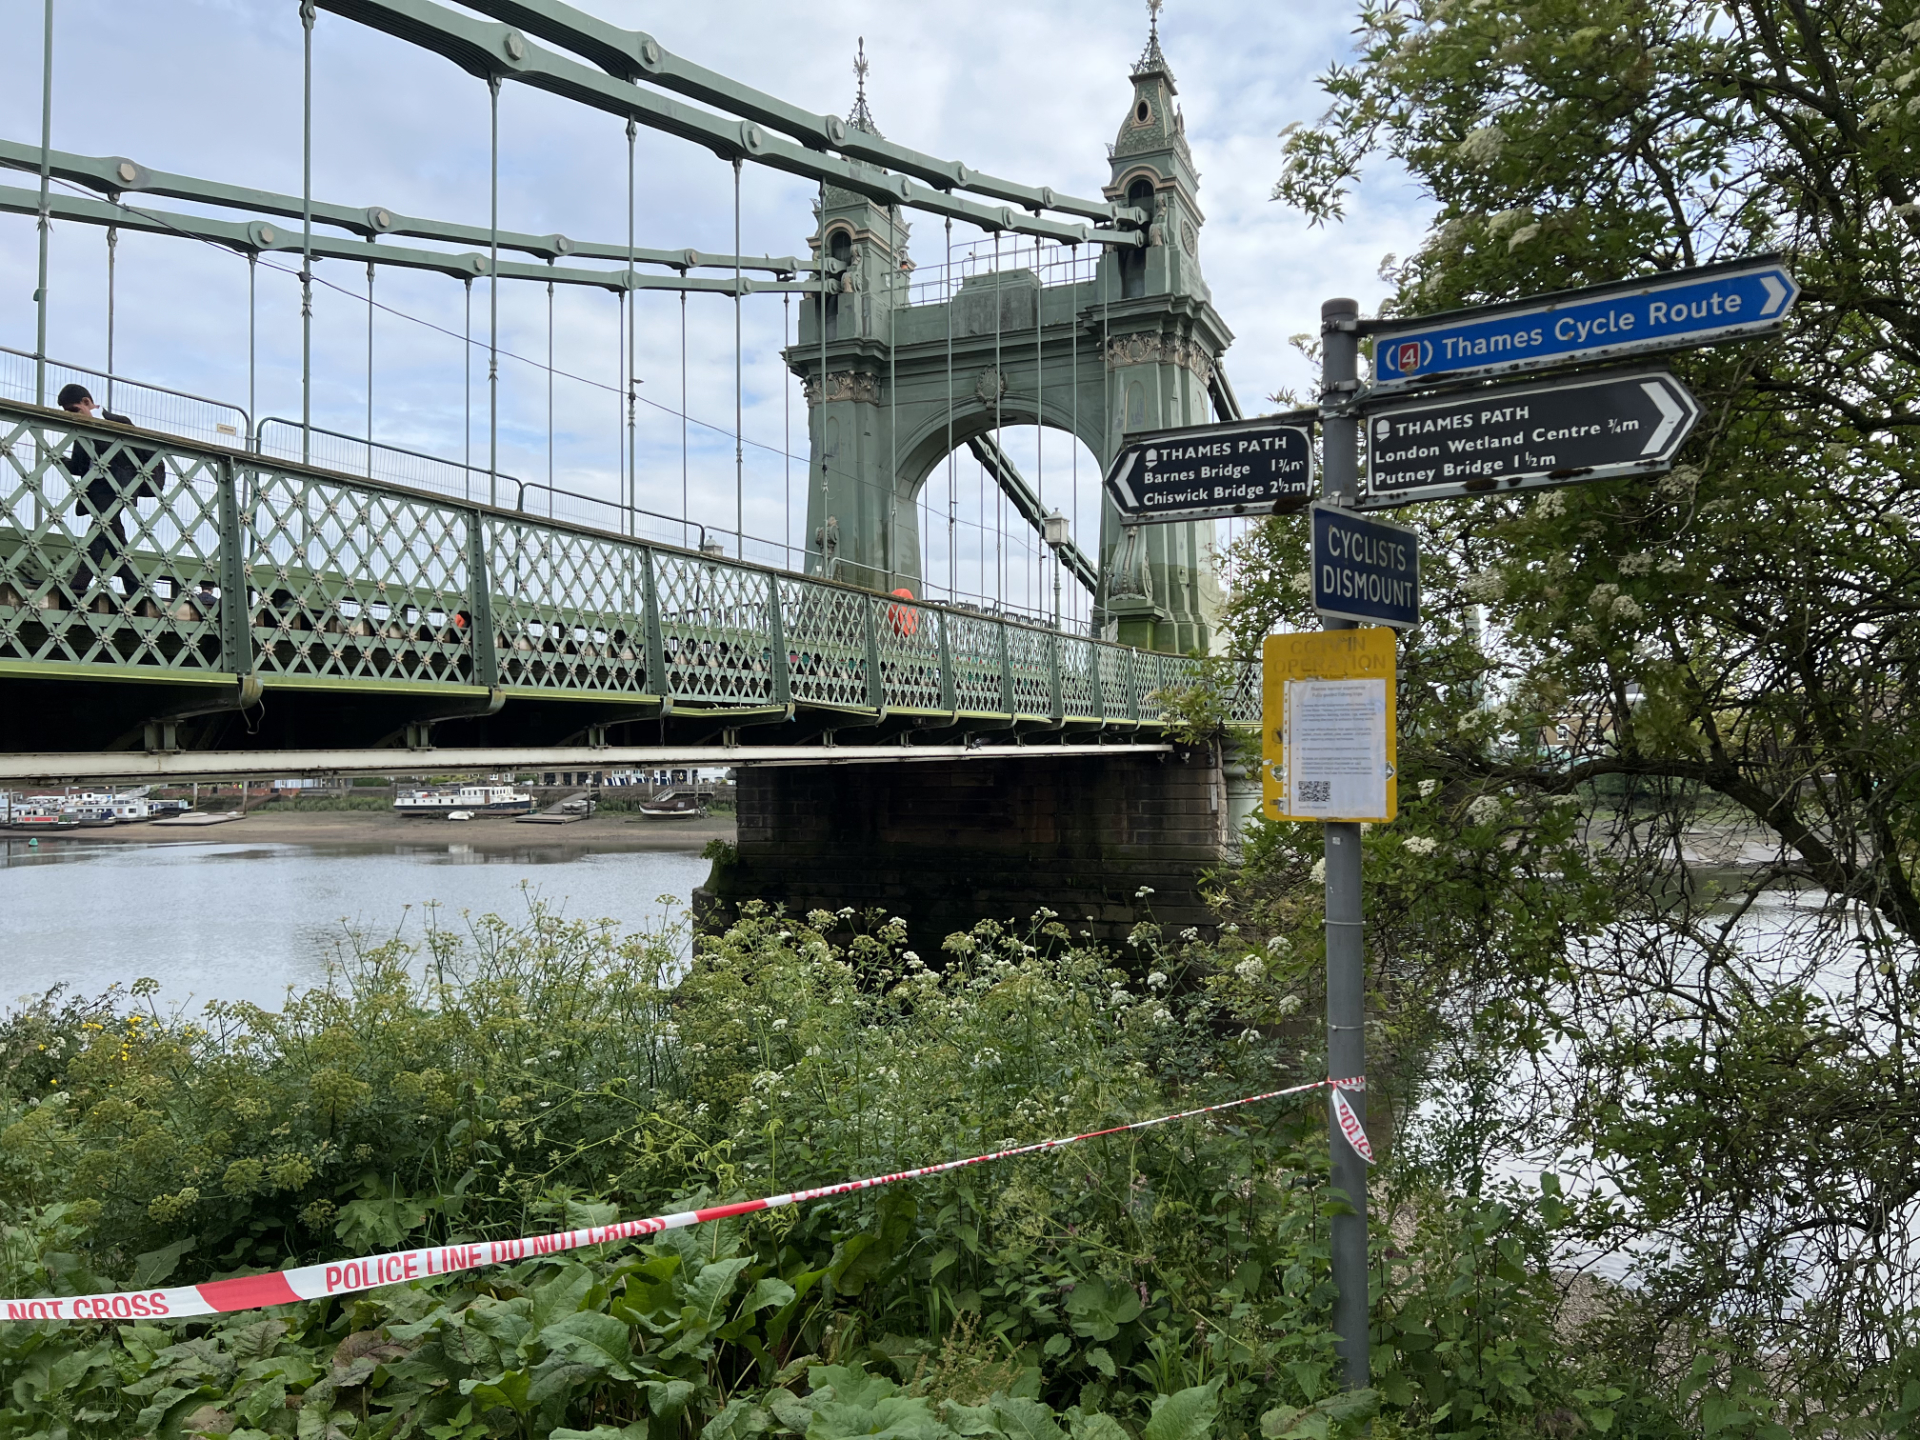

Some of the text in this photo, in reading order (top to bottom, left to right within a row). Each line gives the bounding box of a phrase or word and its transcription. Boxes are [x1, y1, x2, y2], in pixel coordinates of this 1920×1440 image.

[1441, 328, 1543, 359] Thames
[1555, 310, 1635, 343] Cycle
[1649, 292, 1742, 325] Route
[1396, 405, 1529, 437] THAMES PATH
[1160, 436, 1288, 461] THAMES PATH
[1375, 445, 1440, 464] London
[1447, 431, 1524, 453] Wetland
[1532, 424, 1602, 443] Centre
[1144, 470, 1195, 484] Barnes
[1201, 463, 1251, 478] Bridge
[1375, 468, 1436, 486] Putney
[1443, 460, 1504, 476] Bridge
[1143, 487, 1209, 506] Chiswick
[1214, 484, 1264, 499] Bridge
[1328, 526, 1406, 571] CYCLISTS
[1323, 564, 1413, 608] DISMOUNT
[1347, 636, 1366, 652] IN
[1273, 653, 1386, 673] OPERATION
[325, 1252, 419, 1292] POLICE
[426, 1244, 482, 1275] LINE
[490, 1239, 525, 1263] DO
[7, 1292, 169, 1320] NOT CROSS
